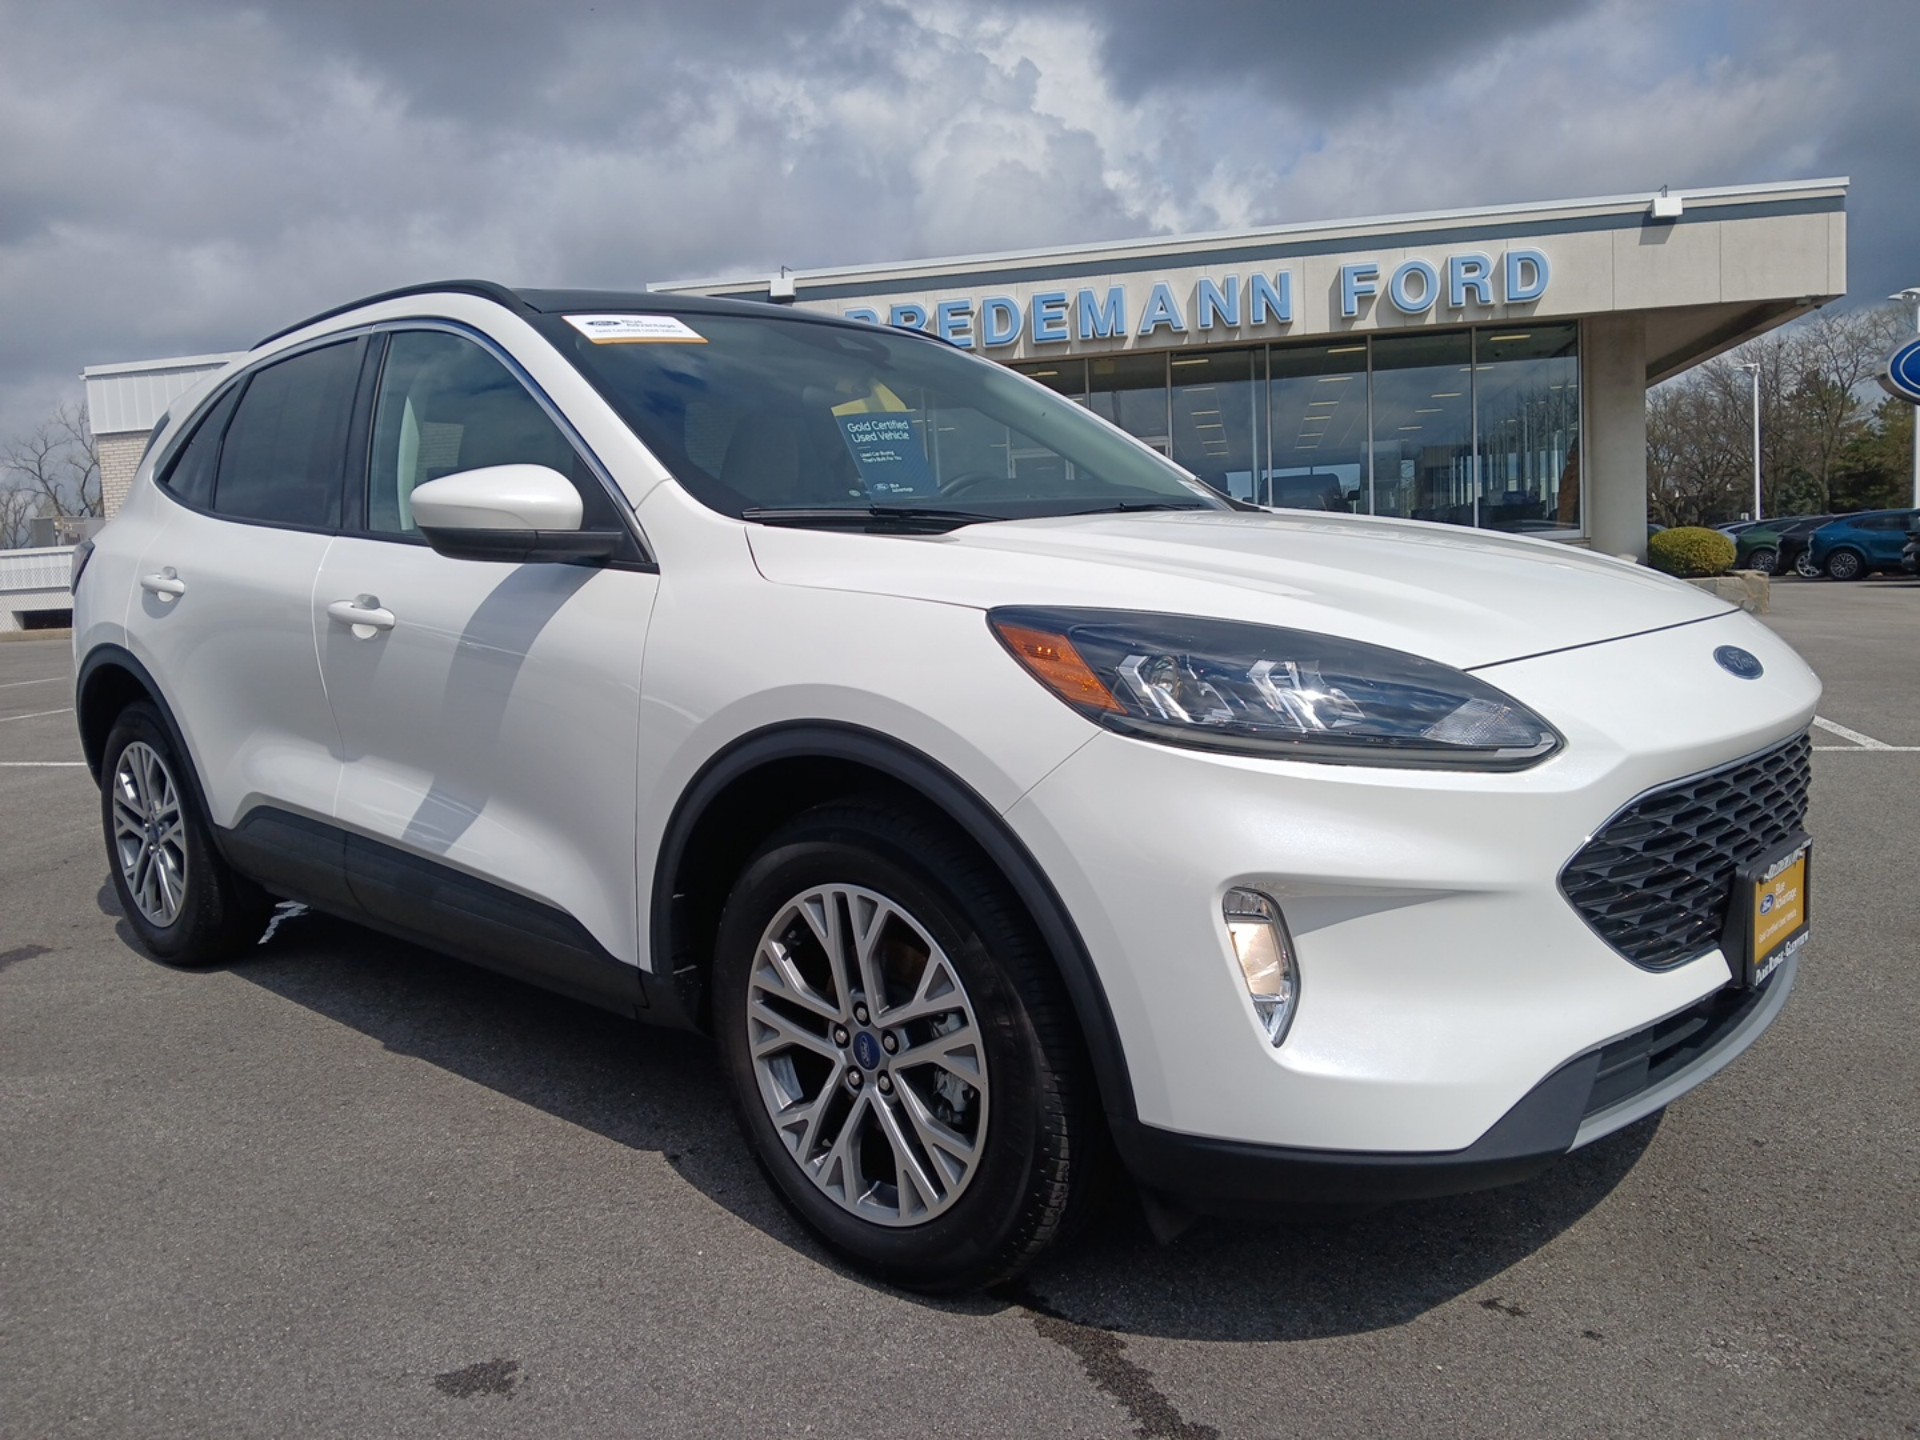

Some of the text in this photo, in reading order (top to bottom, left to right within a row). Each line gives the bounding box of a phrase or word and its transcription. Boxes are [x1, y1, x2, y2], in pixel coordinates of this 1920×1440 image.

[1340, 247, 1551, 318] FORD
[847, 419, 909, 432] Gold Certified
[851, 430, 910, 443] Used Vehicle
